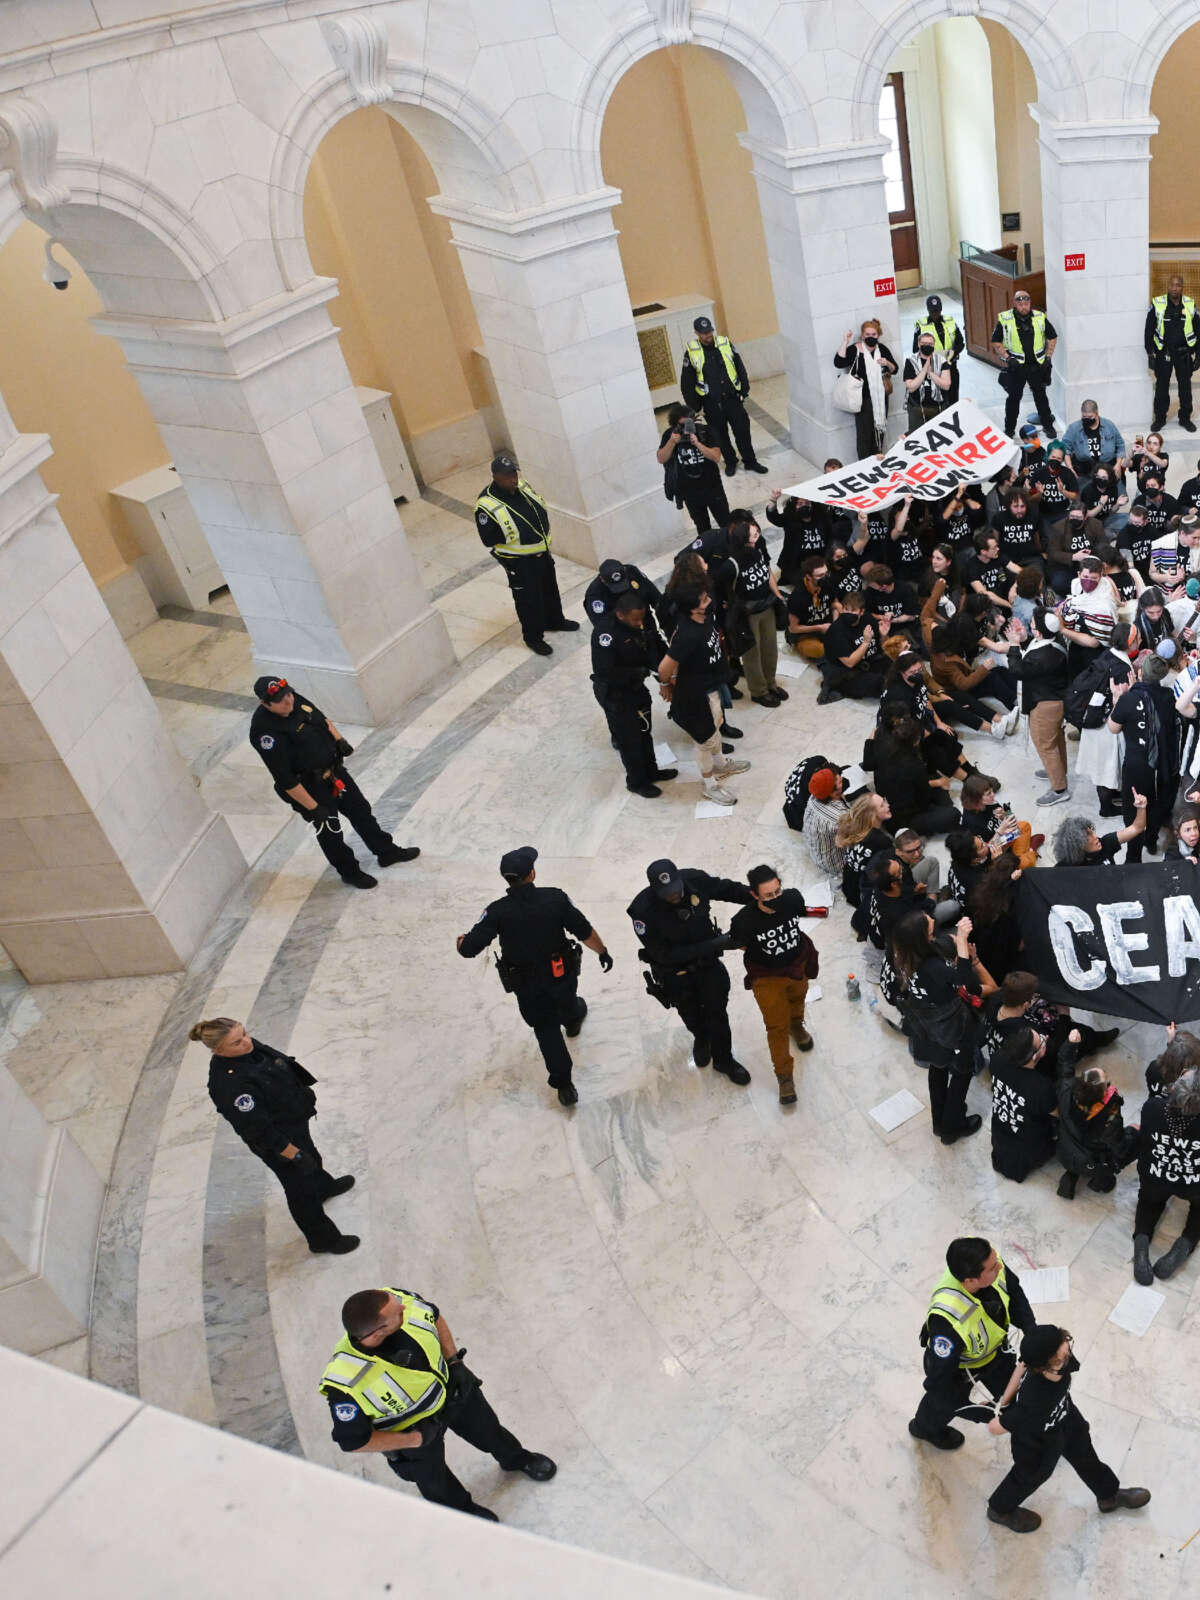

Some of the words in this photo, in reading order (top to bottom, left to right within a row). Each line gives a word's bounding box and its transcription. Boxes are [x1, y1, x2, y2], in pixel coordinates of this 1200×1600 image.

[1067, 258, 1083, 267] EXIT
[876, 282, 894, 292] EXIT
[818, 456, 908, 498] JEWS
[905, 411, 965, 456] SAY
[825, 426, 1007, 509] EAEFIRE
[1008, 531, 1029, 539] OUR
[1070, 540, 1090, 550] OUR
[749, 565, 769, 583] OUR
[757, 925, 785, 942] NOT
[788, 915, 801, 928] IN
[767, 928, 799, 949] OUR
[1152, 1132, 1200, 1150] JEWS
[1151, 1149, 1200, 1166] CEASE
[1157, 1144, 1192, 1159] SAY
[1150, 1164, 1200, 1184] NOW
[1157, 1162, 1194, 1174] FIRE
